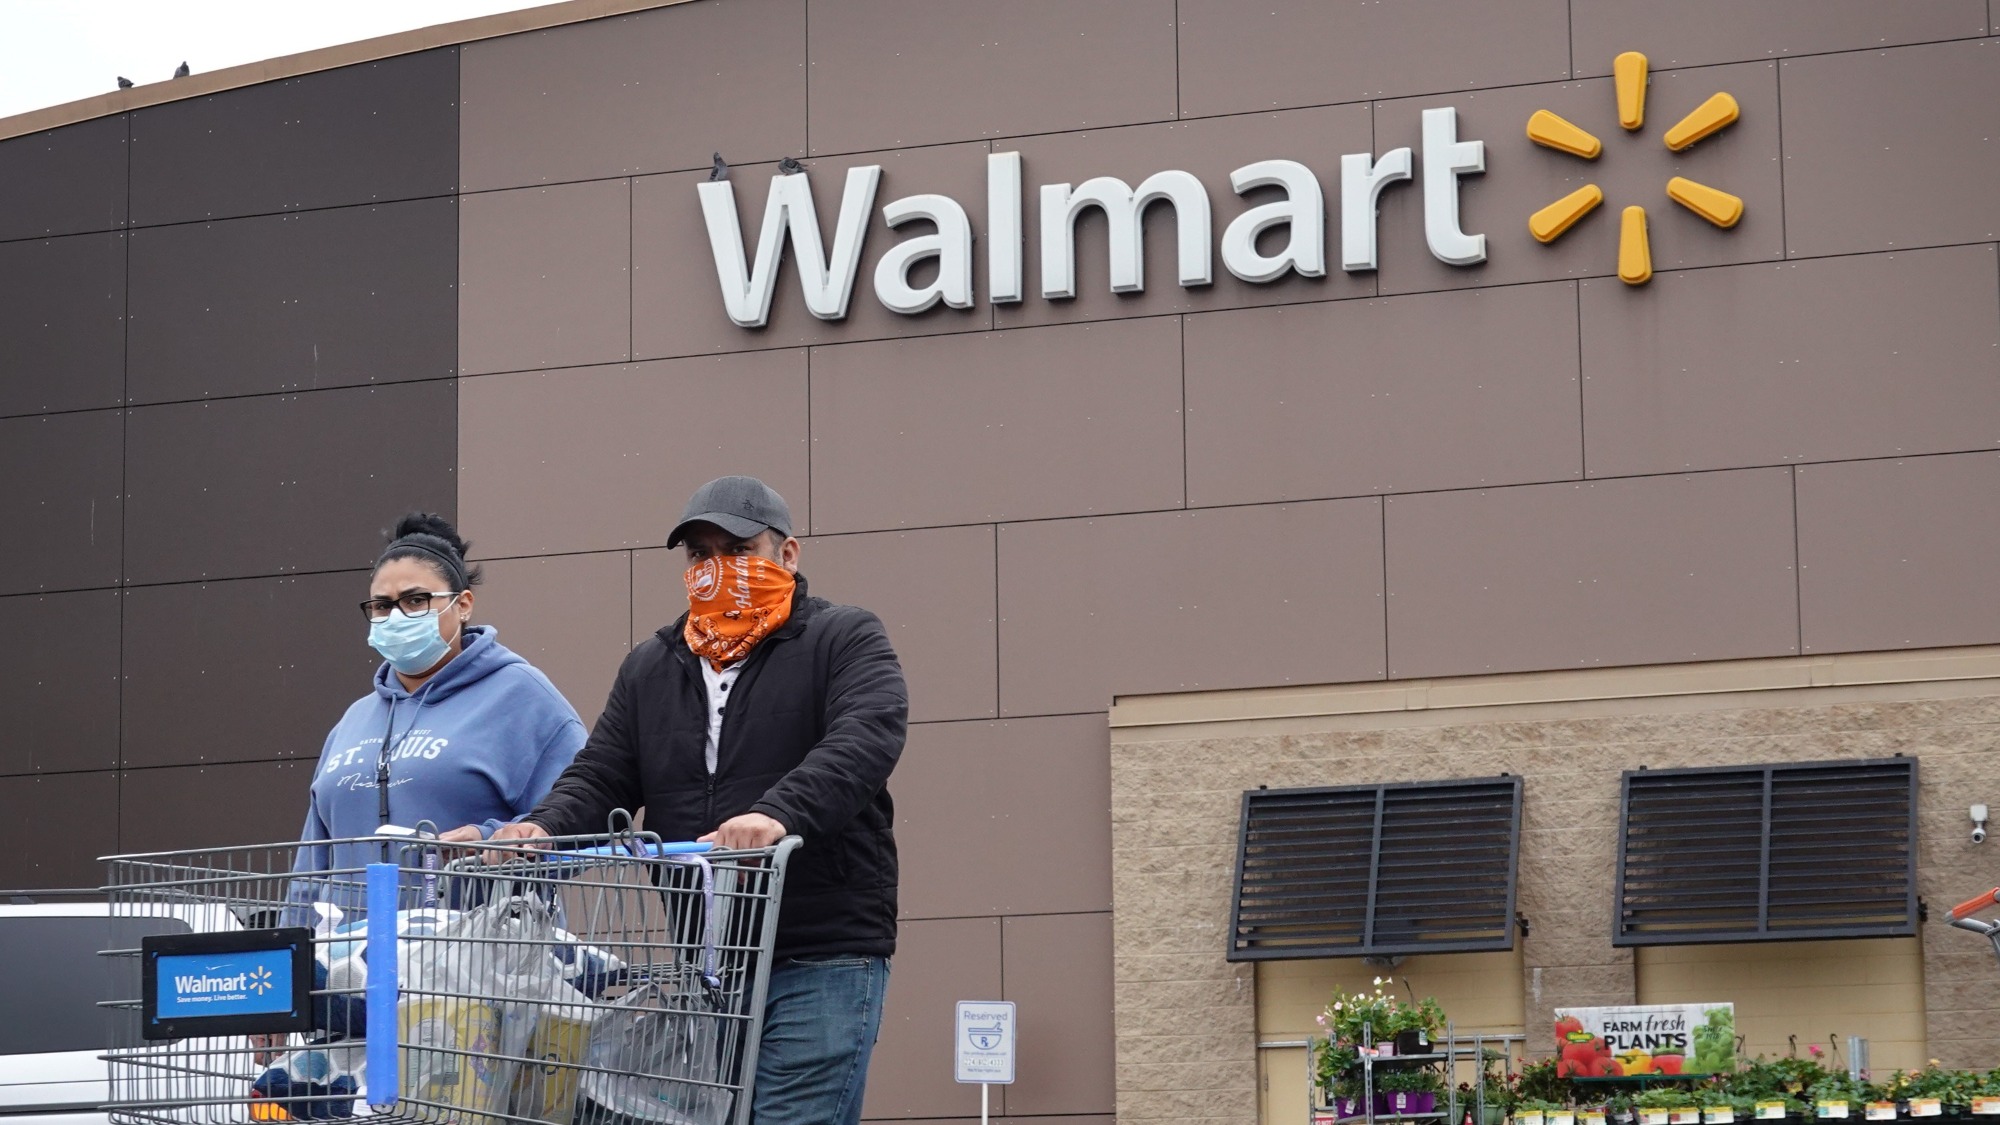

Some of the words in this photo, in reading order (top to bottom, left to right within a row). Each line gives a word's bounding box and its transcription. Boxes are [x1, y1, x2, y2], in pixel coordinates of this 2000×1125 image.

[697, 107, 1486, 328] Walmart
[326, 746, 364, 773] ST.
[337, 772, 413, 790] Missuri
[174, 972, 247, 994] Walmart
[963, 1010, 1008, 1021] Reserved
[1603, 1021, 1643, 1032] FARM
[1645, 1014, 1686, 1032] fresh
[1604, 1033, 1688, 1050] PLANTS
